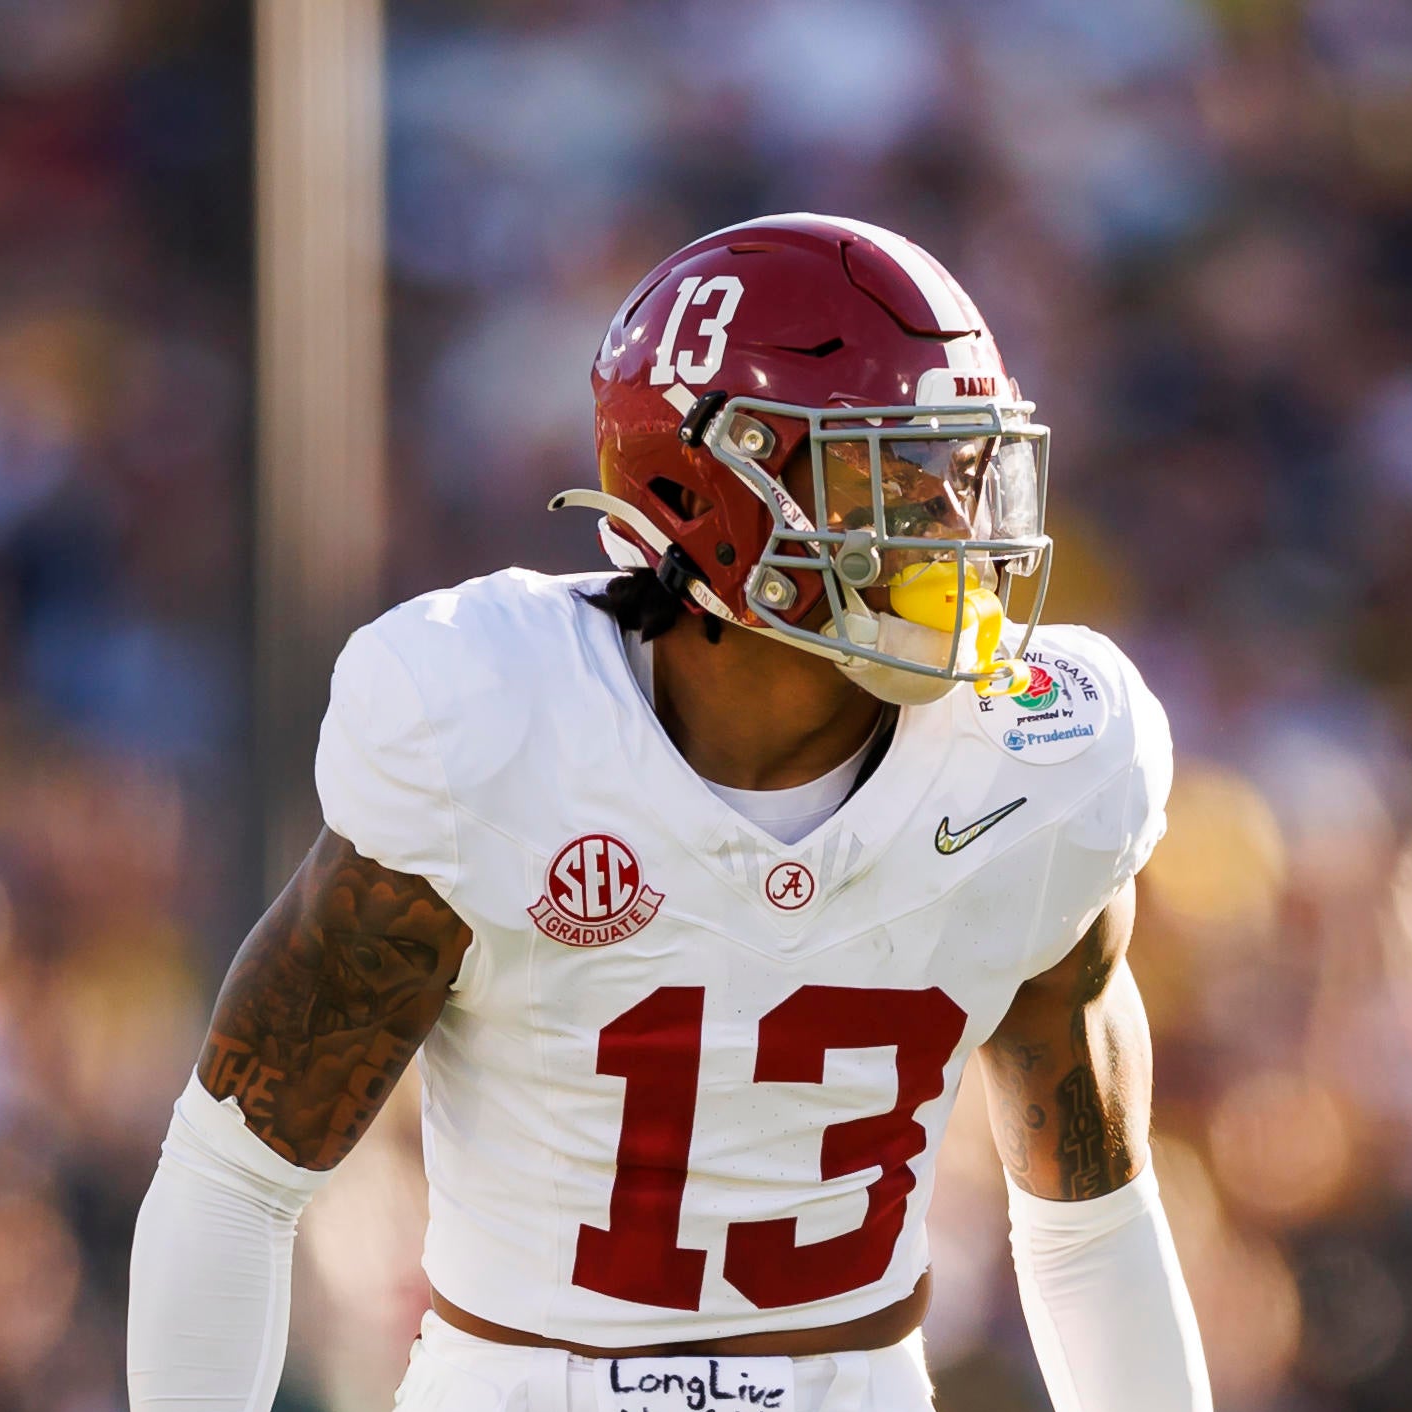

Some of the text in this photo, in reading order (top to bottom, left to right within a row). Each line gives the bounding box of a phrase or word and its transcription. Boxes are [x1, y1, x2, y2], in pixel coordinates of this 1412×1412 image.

[650, 275, 745, 385] 13
[1054, 659, 1098, 701] GAME
[1017, 708, 1073, 726] presented by
[1027, 723, 1094, 745] Prudential
[554, 839, 634, 918] SEC
[772, 869, 804, 900] A
[545, 908, 647, 945] GRADUATE
[571, 984, 969, 1312] 13
